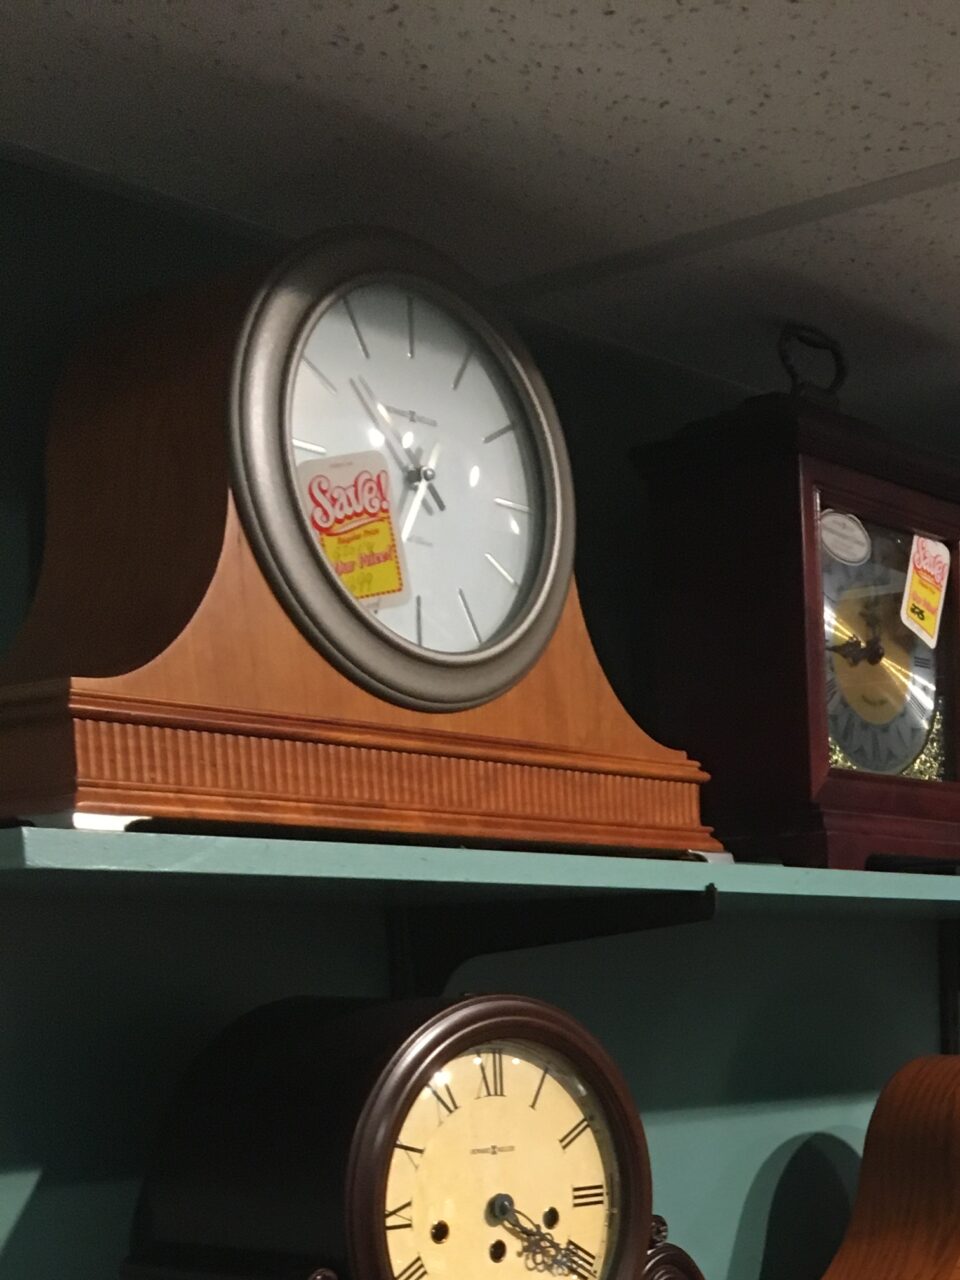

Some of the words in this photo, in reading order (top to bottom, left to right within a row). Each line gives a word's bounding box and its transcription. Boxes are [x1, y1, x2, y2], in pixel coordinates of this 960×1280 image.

[309, 470, 390, 533] Save!
[474, 1049, 506, 1100] XII
[528, 1067, 549, 1111] I
[559, 1112, 594, 1151] II
[571, 1182, 605, 1209] III
